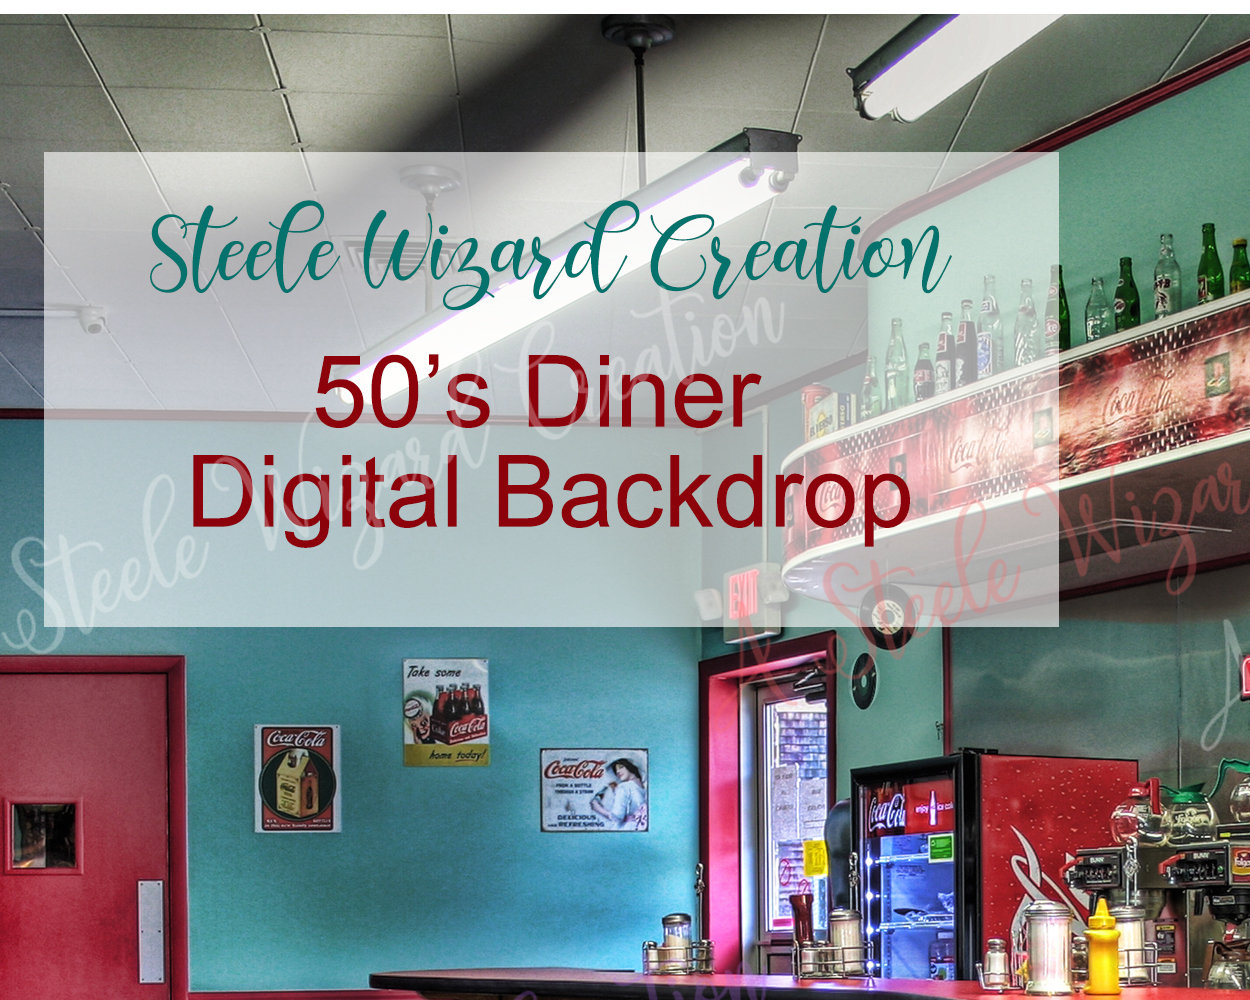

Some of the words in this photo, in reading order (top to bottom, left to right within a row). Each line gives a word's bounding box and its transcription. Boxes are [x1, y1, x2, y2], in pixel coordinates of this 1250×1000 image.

[729, 568, 760, 620] EXIT
[407, 665, 430, 679] Take
[435, 669, 462, 678] some
[266, 729, 328, 747] Coca-Cola
[428, 749, 452, 760] home
[456, 748, 487, 762] today!
[543, 759, 608, 779] Coca-Cola
[915, 805, 929, 814] enjoy
